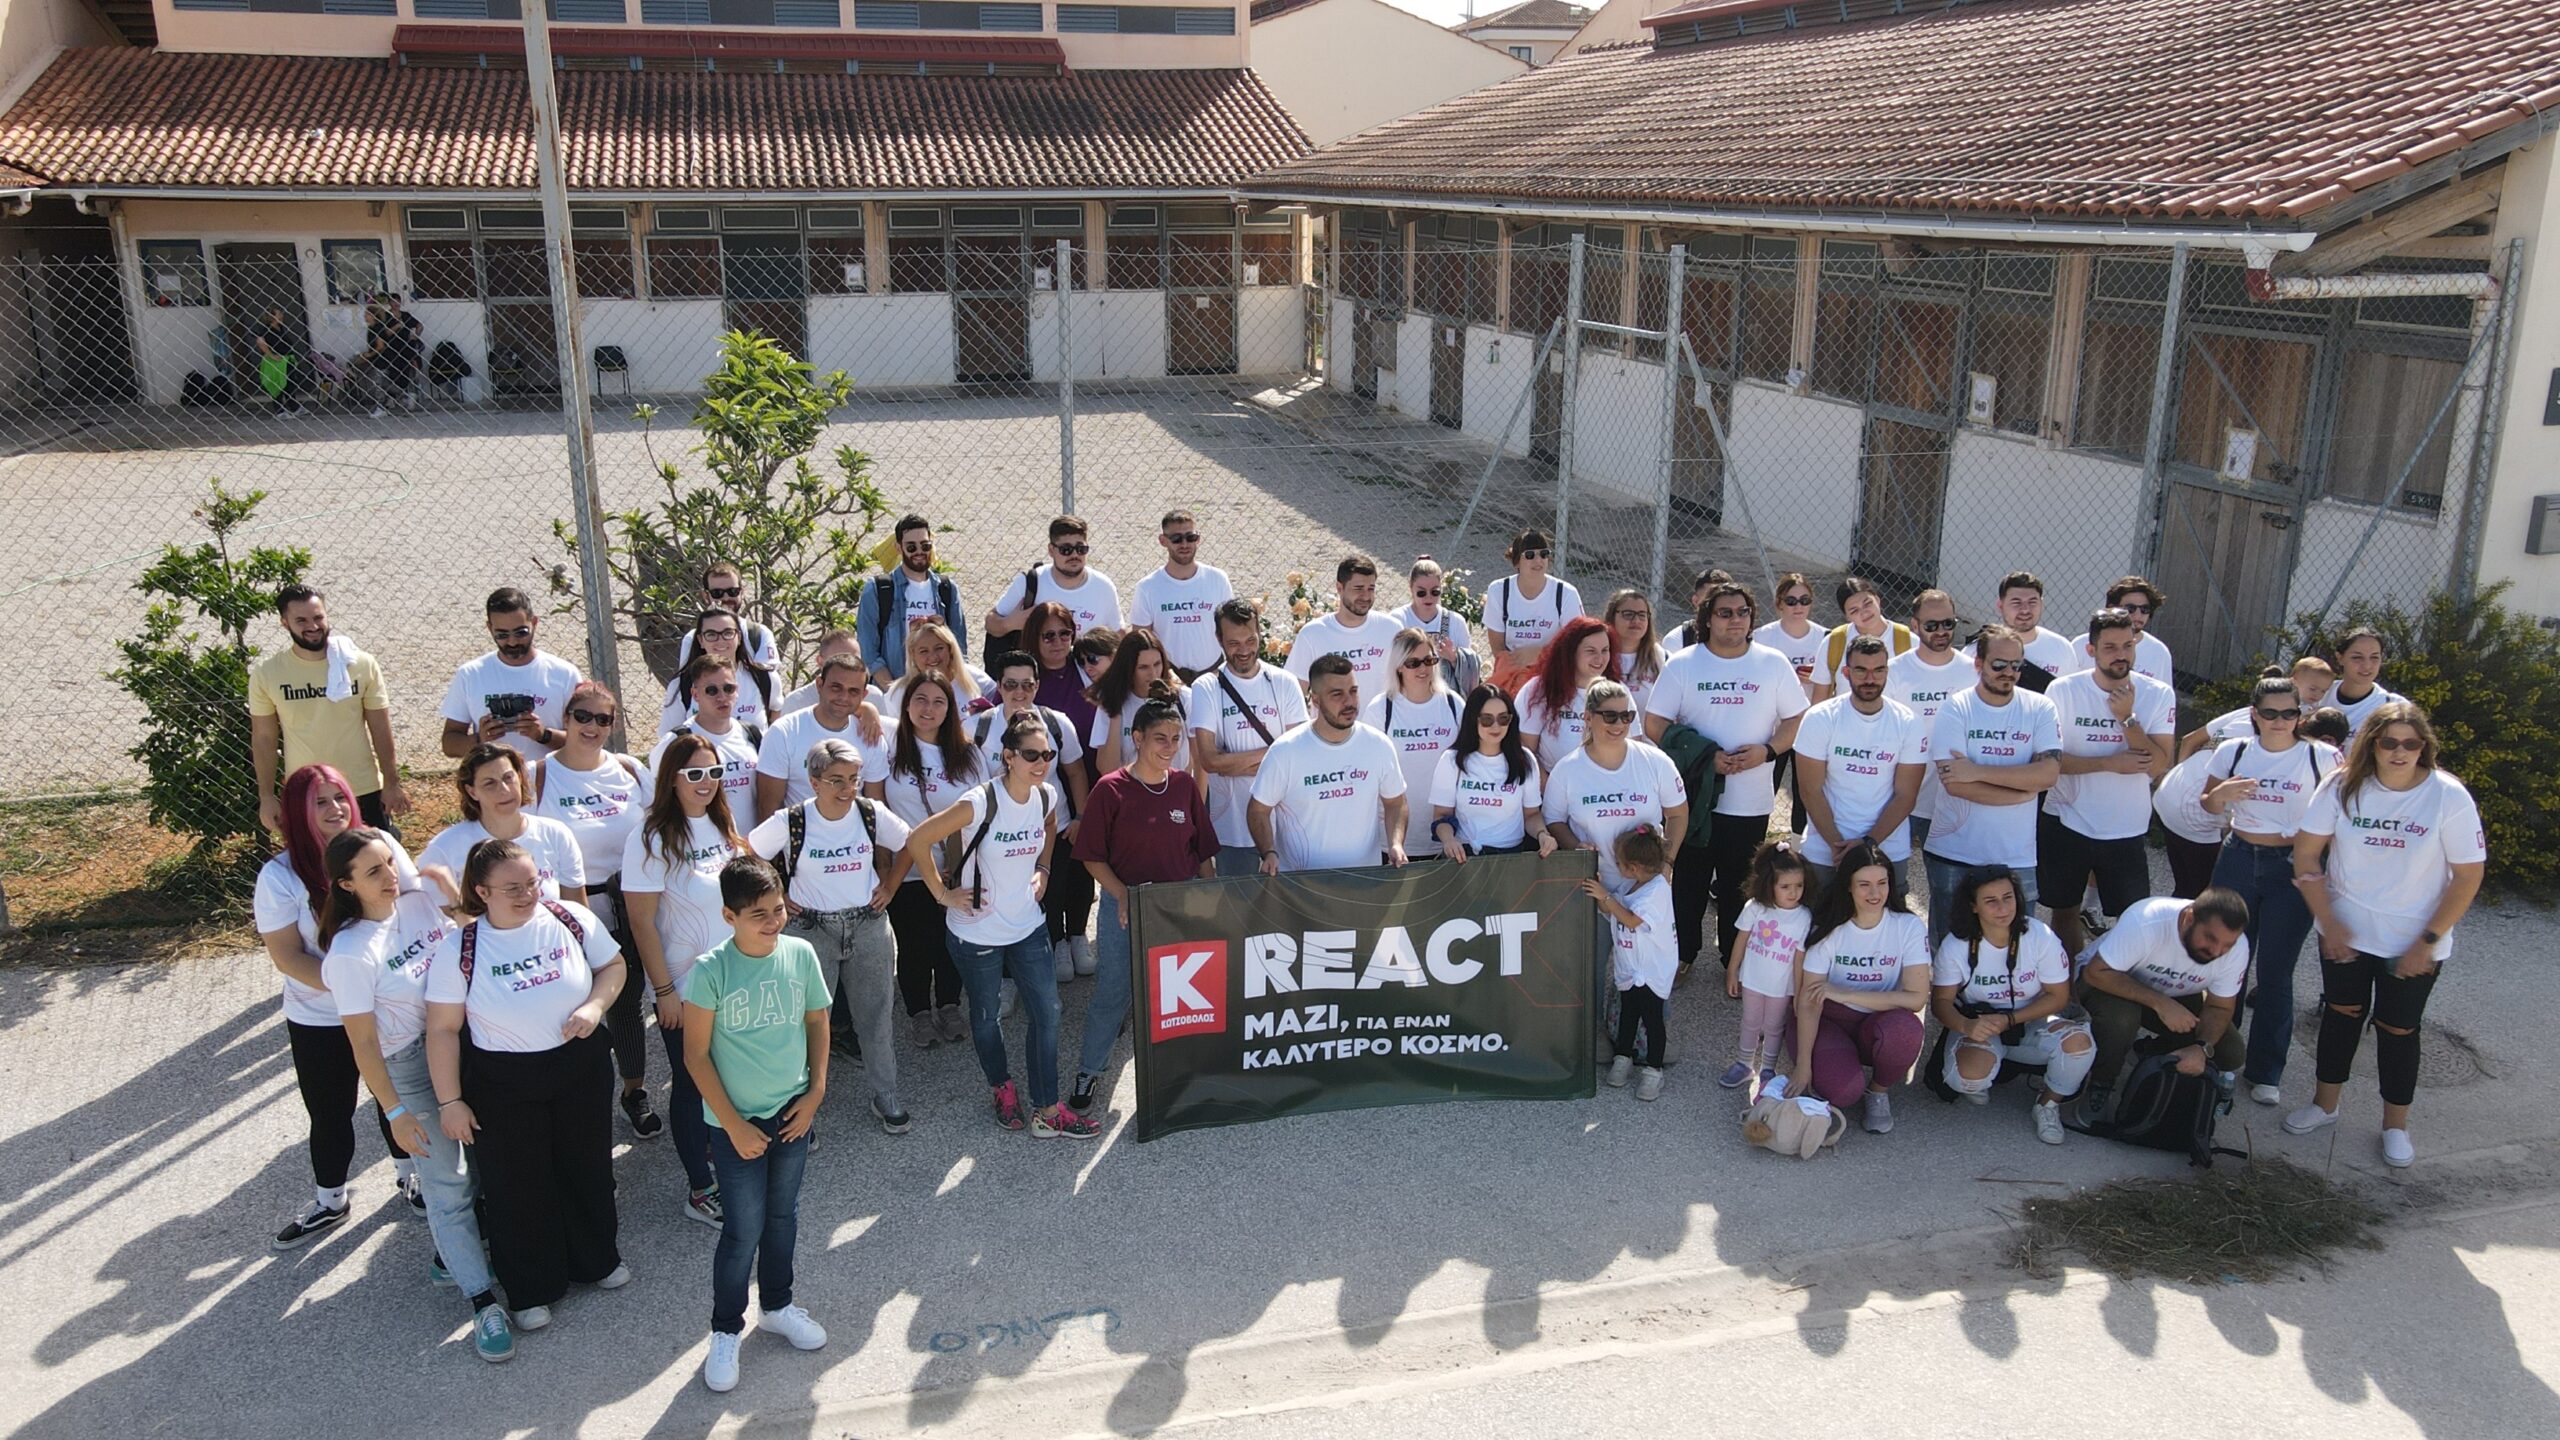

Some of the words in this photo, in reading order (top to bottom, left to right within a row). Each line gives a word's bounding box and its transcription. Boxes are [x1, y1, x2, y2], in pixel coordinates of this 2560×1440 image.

[1161, 602, 1195, 612] REACT
[1198, 600, 1213, 611] day
[1080, 610, 1096, 621] day
[1173, 615, 1201, 624] 22.10.23
[1508, 619, 1537, 628] REACT
[1539, 619, 1553, 629] day
[1515, 631, 1541, 639] 22.10.23
[1368, 646, 1384, 657] day
[1698, 682, 1737, 692] REACT
[1741, 680, 1760, 693] day
[1711, 696, 1744, 705] 22.10.23
[1911, 691, 1949, 702] REACT
[738, 704, 756, 714] day
[1262, 704, 1277, 717] day
[2075, 717, 2116, 728] REACT
[1393, 728, 1430, 738] REACT
[1434, 726, 1451, 737] day
[1968, 729, 2007, 741] REACT
[2012, 731, 2031, 744] day
[2086, 733, 2123, 743] 22.10.23
[1405, 742, 1439, 752] 22.10.23
[1835, 745, 1872, 758] REACT
[1875, 751, 1895, 763] day
[1846, 763, 1878, 775] 22.10.23
[723, 777, 749, 788] 2.10.23
[1304, 771, 1345, 786] REACT
[1350, 768, 1369, 780] day
[1461, 779, 1496, 792] REACT
[1500, 782, 1517, 795] day
[2282, 780, 2302, 793] day
[1318, 788, 1354, 801] 22.10.23
[1582, 793, 1624, 804] REACT
[1629, 791, 1648, 804] day
[1468, 796, 1503, 807] 22.10.23
[1596, 808, 1635, 818] 22.10.23
[2351, 815, 2401, 832] REACT
[2404, 821, 2429, 837] day
[994, 830, 1029, 843] REACT
[2363, 836, 2406, 849] 22.10.23
[810, 846, 852, 859] REACT
[1004, 845, 1037, 857] 22.10.23
[824, 861, 862, 874] 22.10.23
[387, 939, 425, 972] REACT
[427, 928, 444, 943] day
[1243, 911, 1538, 999] REACT
[491, 954, 543, 977] REACT
[549, 945, 569, 963] day
[1835, 954, 1874, 967] REACT
[1879, 954, 1897, 967] day
[513, 970, 561, 992] 22.10.23
[1846, 972, 1882, 982] 22.10.23
[1244, 1005, 1349, 1041] ΜΑΖΙ,
[1356, 1015, 1390, 1030] ΓΙΑ
[1393, 1013, 1451, 1029] ΕΝΑΝ
[1242, 1037, 1392, 1070] ΚΑΛΥΤΕΡΟ
[1400, 1032, 1510, 1055] ΚΟΣΜΟ.
